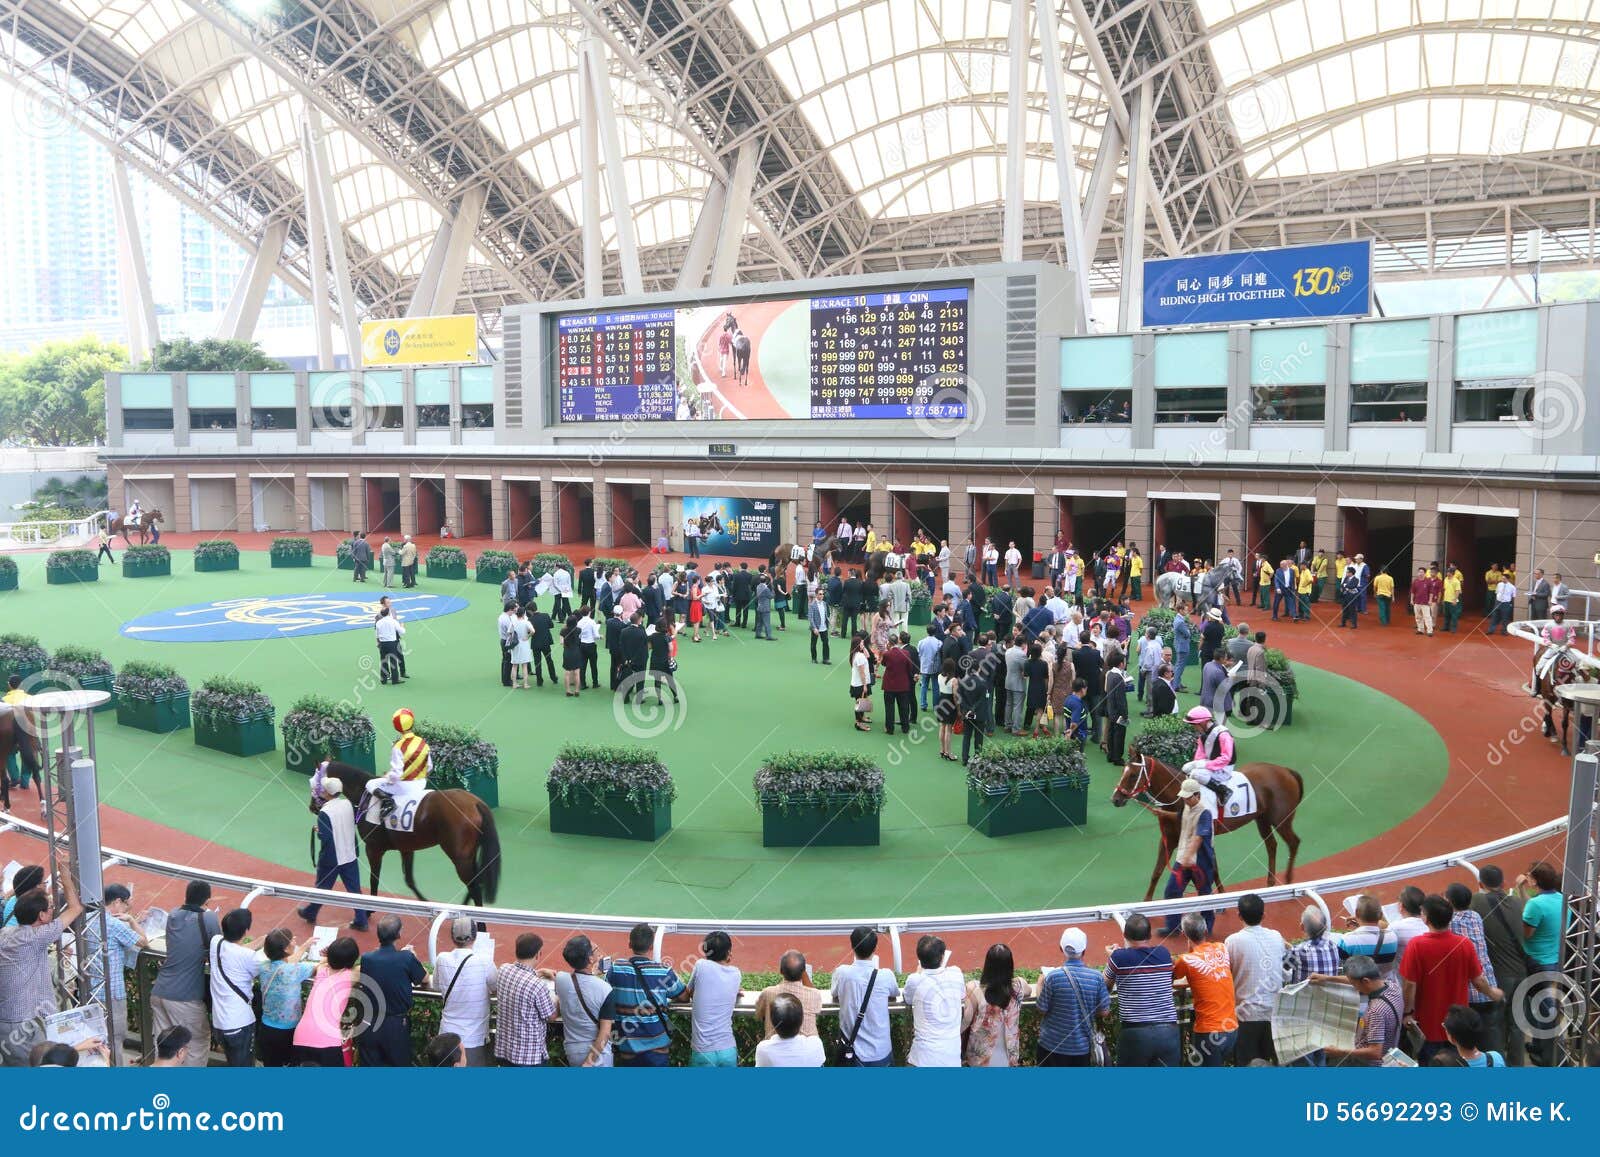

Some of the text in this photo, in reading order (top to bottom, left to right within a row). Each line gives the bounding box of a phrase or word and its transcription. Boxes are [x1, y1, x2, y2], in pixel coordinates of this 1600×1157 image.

[1177, 273, 1266, 292] 同心 同步 同進
[829, 293, 928, 307] RACE 10 QIN
[1160, 289, 1285, 307] RIDING HIGH TOGETHER
[841, 309, 958, 324] 196 129 9.8 204 48 213
[822, 328, 837, 337] 242
[860, 327, 876, 336] 343
[882, 326, 892, 334] 71
[899, 324, 916, 334] 360
[919, 323, 936, 332] 142
[940, 322, 958, 332] 715
[825, 340, 835, 349] 12
[840, 339, 856, 348] 169
[881, 339, 892, 348] 41
[898, 338, 916, 347] 247
[919, 337, 935, 346] 141
[940, 336, 958, 346] 340
[822, 353, 837, 362] 999
[840, 352, 855, 361] 999
[858, 351, 874, 360] 970
[902, 351, 912, 360] 61
[922, 351, 932, 360] 11
[943, 350, 955, 359] 63
[822, 364, 837, 374] 597
[840, 364, 855, 373] 999
[858, 363, 874, 372] 601
[878, 362, 894, 371] 999
[920, 364, 936, 373] 153
[940, 364, 958, 373] 452
[822, 377, 837, 386] 108
[840, 376, 855, 385] 765
[859, 376, 874, 385] 146
[878, 375, 894, 384] 999
[897, 374, 913, 384] 999
[940, 378, 958, 387] 200
[822, 389, 837, 398] 591
[840, 388, 855, 398] 999
[859, 388, 874, 397] 747
[878, 387, 894, 396] 999
[897, 387, 913, 396] 999
[916, 387, 933, 396] 999
[907, 407, 912, 415] $
[915, 406, 963, 416] 27,587,741
[1237, 783, 1250, 812] 7
[401, 800, 416, 830] 6
